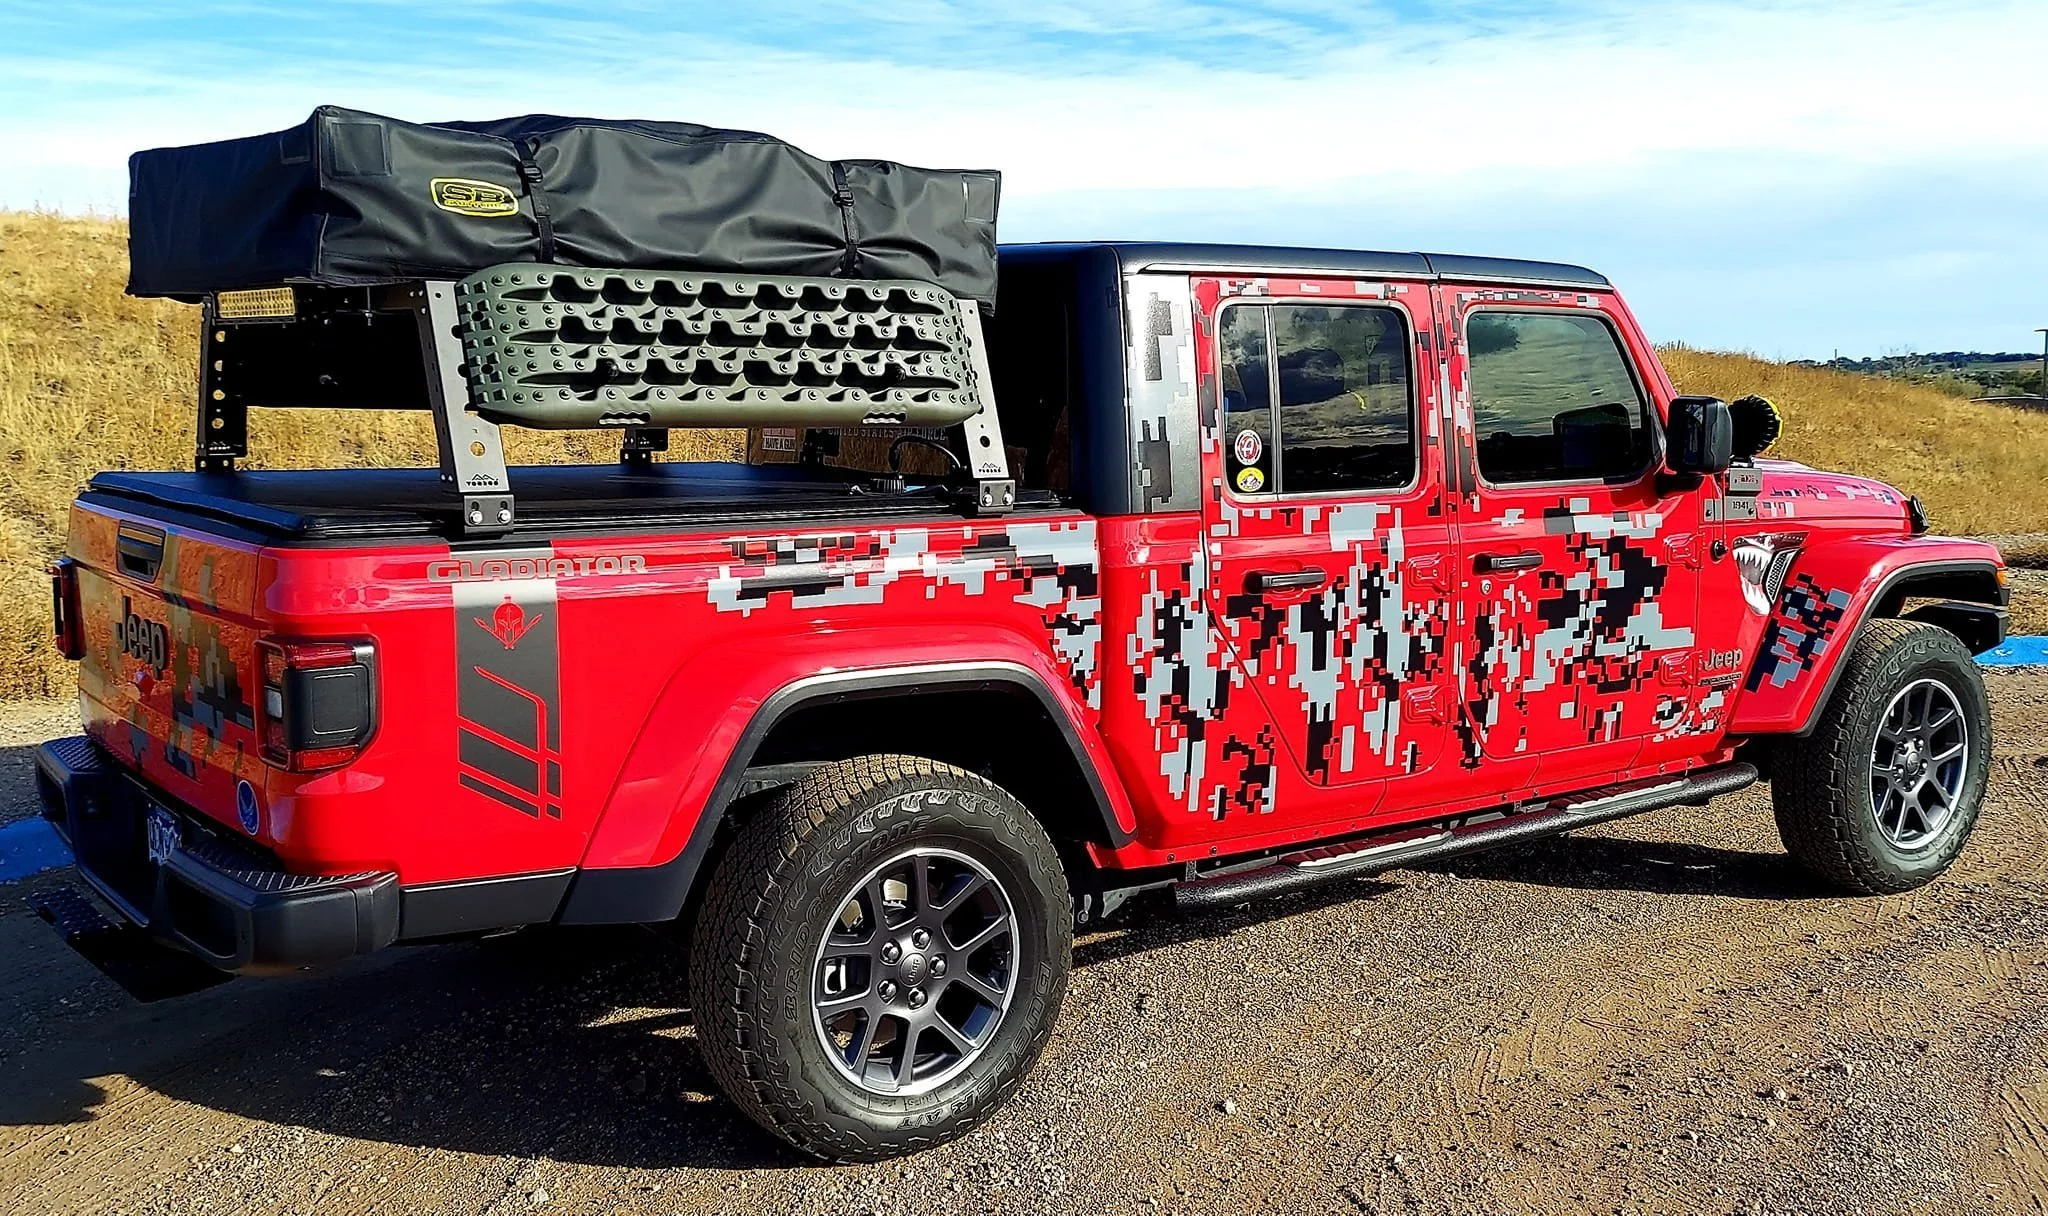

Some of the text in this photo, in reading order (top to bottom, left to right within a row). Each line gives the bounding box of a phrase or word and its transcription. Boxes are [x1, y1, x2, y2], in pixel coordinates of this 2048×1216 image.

[442, 184, 504, 203] SB
[1732, 501, 1749, 510] 1941
[427, 555, 648, 583] GLADIATOR
[113, 595, 167, 680] Jeep
[1703, 649, 1743, 671] Jeep
[783, 815, 930, 1022] BRIDGESTONE
[897, 962, 1051, 1129] DUELER A/T
